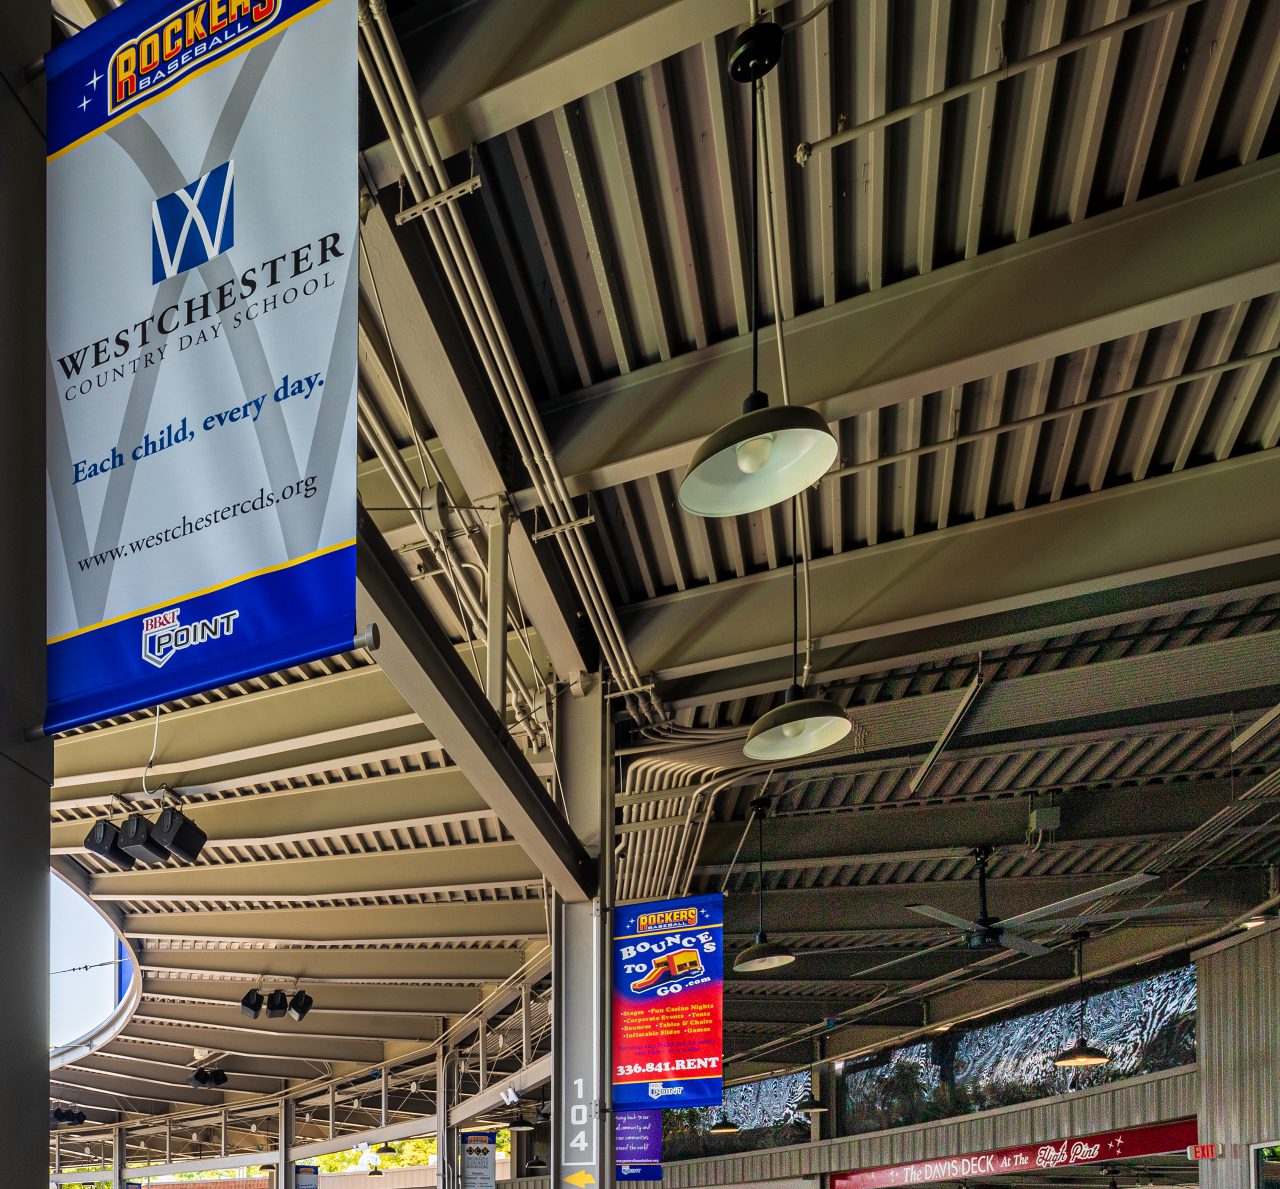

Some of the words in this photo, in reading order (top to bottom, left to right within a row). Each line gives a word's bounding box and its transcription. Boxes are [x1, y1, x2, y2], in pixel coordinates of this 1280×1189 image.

[139, 22, 249, 90] BASEBALL
[57, 232, 345, 381] WESTCHESTER
[65, 343, 168, 401] COUNTRY
[178, 321, 222, 352] DAY
[232, 271, 335, 329] SCHOOL
[71, 446, 125, 485] Each
[131, 417, 195, 462] child,
[202, 393, 268, 432] every
[273, 371, 326, 404] day.
[77, 474, 319, 573] www.westchestercds.org
[144, 608, 179, 632] BB&T
[156, 611, 238, 655] POINT
[639, 908, 697, 931] ROCKERS
[647, 921, 688, 930] BASEBALL
[624, 963, 648, 974] TO
[656, 983, 683, 997] GO
[625, 1016, 660, 1024] Corporate
[661, 1013, 685, 1021] Events
[616, 1056, 720, 1076] 336.841.RENT
[569, 1078, 589, 1151] 104
[902, 1166, 922, 1183] The
[924, 1158, 959, 1180] DAVIS
[961, 1154, 995, 1174] DECK
[1000, 1157, 1012, 1168] At
[1013, 1152, 1030, 1166] The
[1036, 1139, 1068, 1167] High
[1193, 1144, 1216, 1159] EXIT
